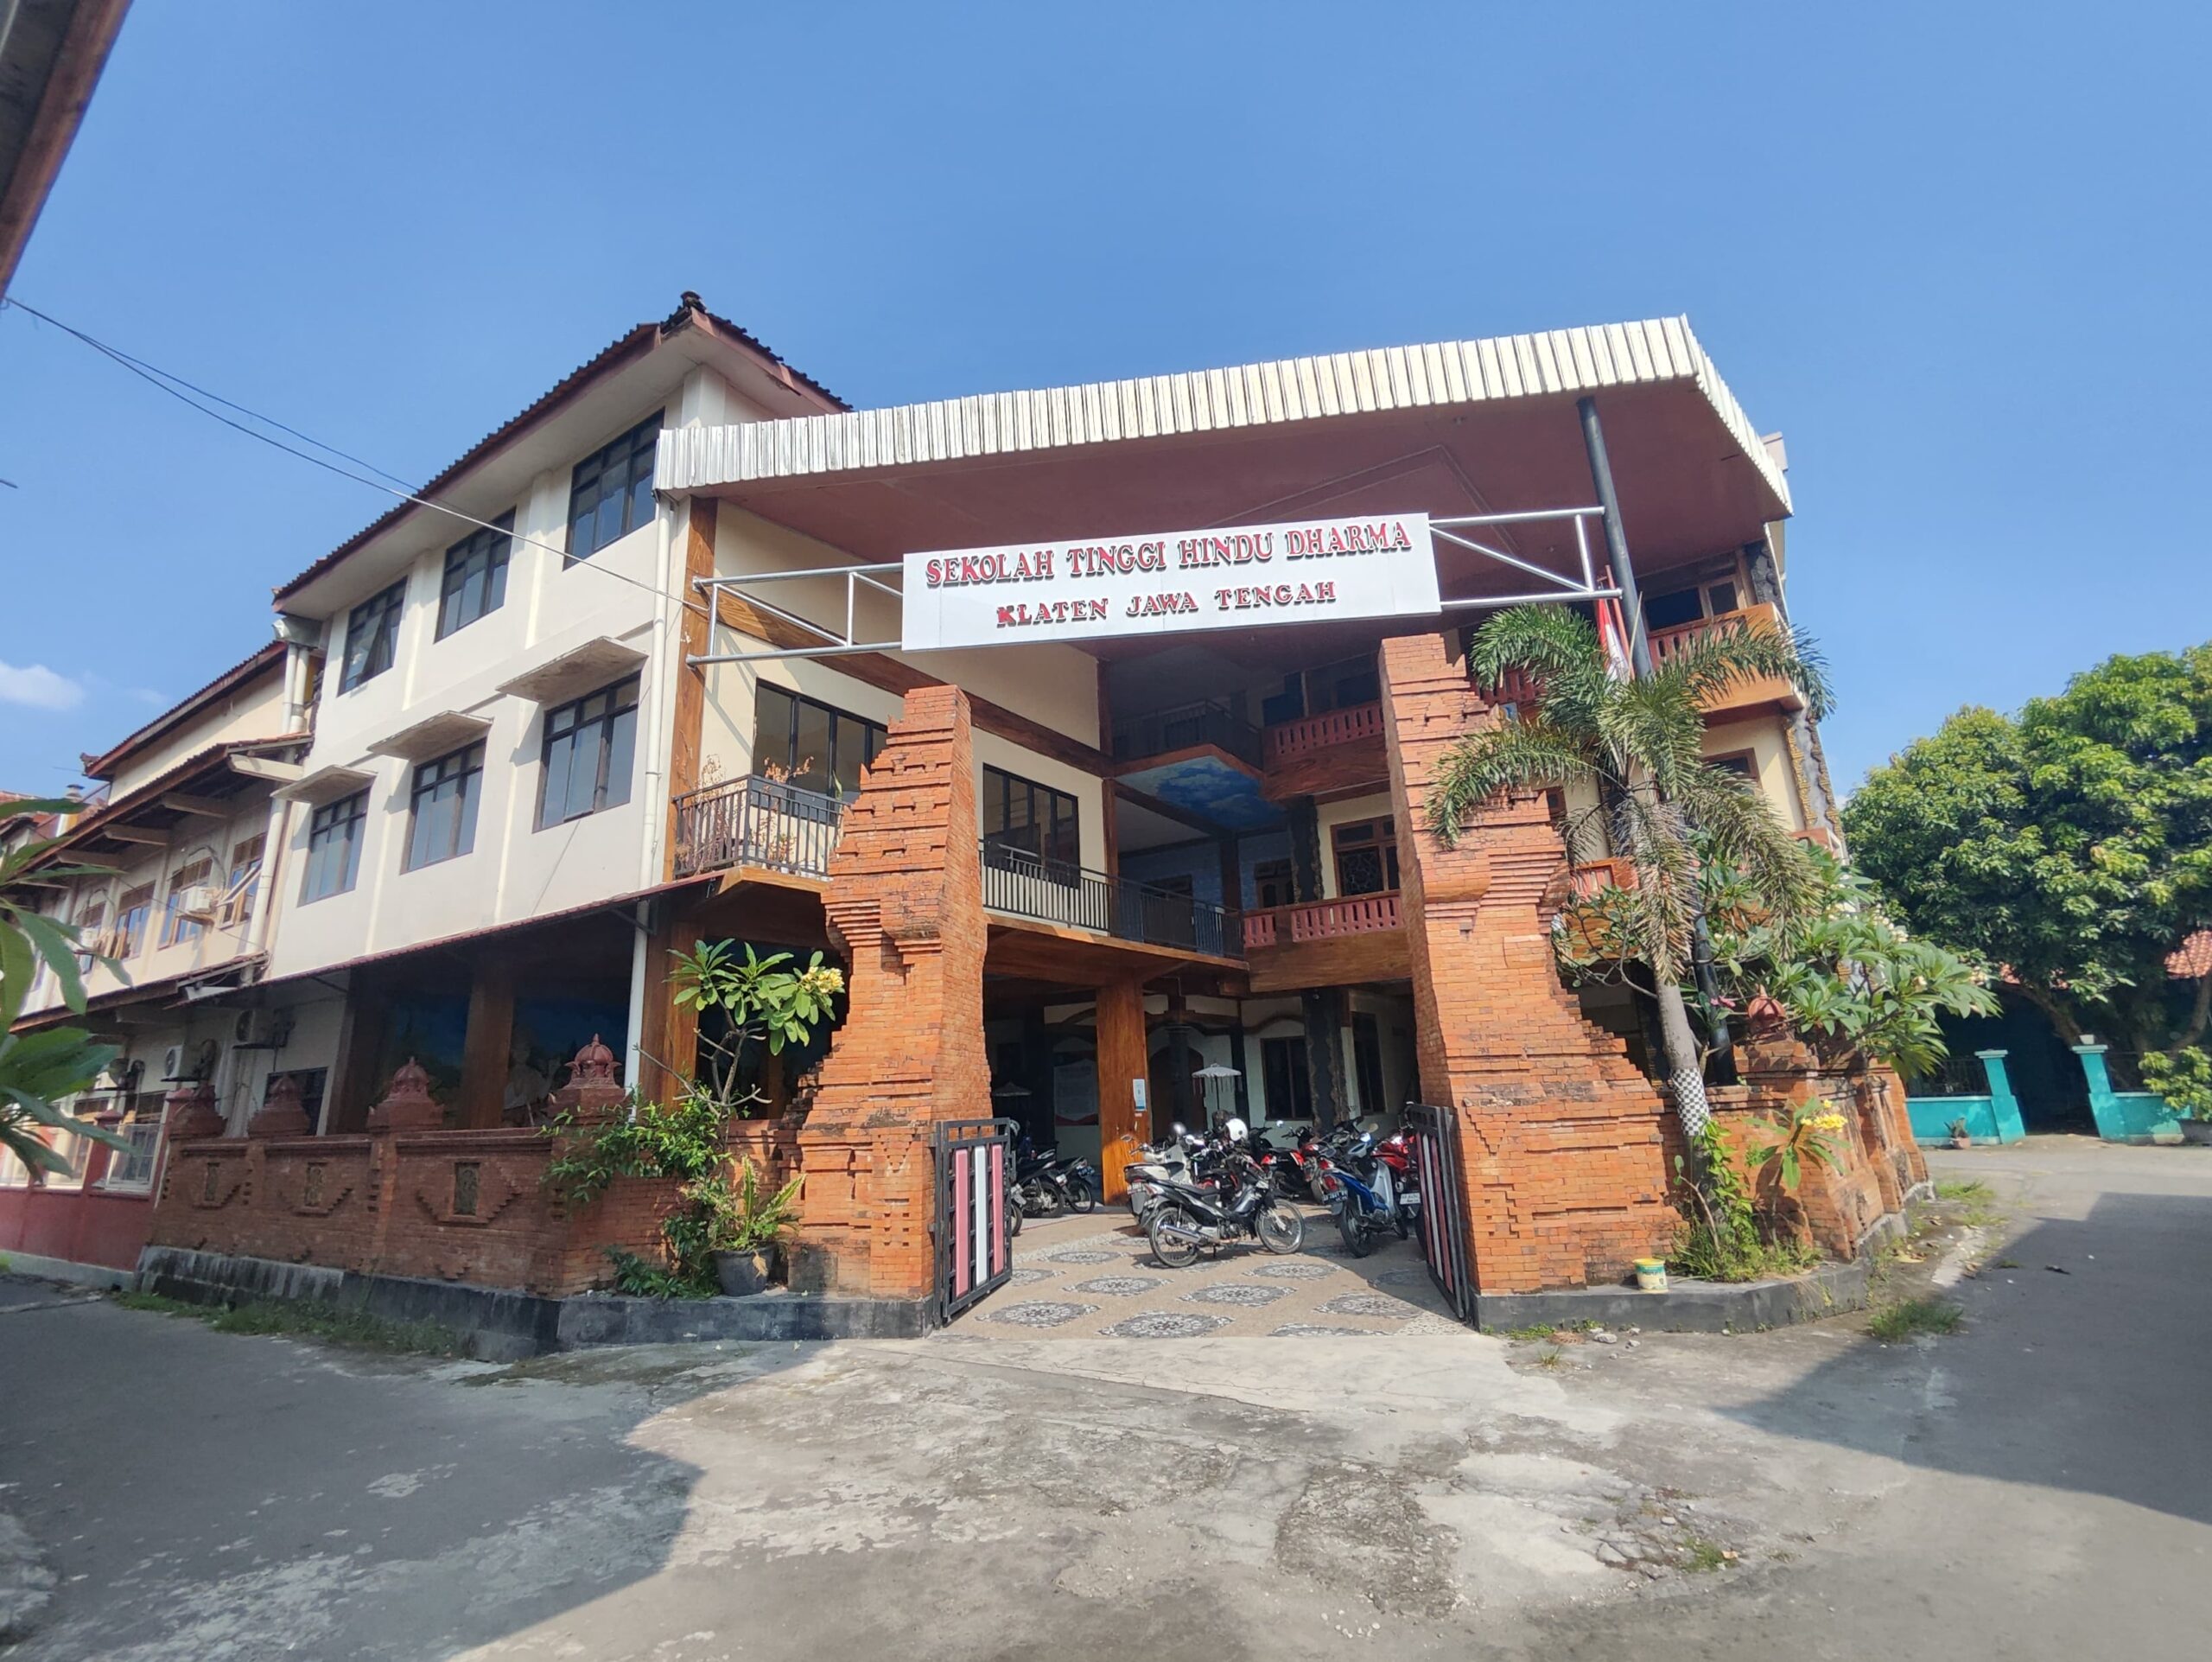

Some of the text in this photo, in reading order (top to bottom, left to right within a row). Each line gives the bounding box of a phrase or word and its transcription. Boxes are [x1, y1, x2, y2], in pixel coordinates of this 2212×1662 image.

[926, 521, 1412, 587] SEKOLAH TINGGI HINDU DHARMA
[997, 581, 1337, 627] KLATEN JAWA TENGAH
